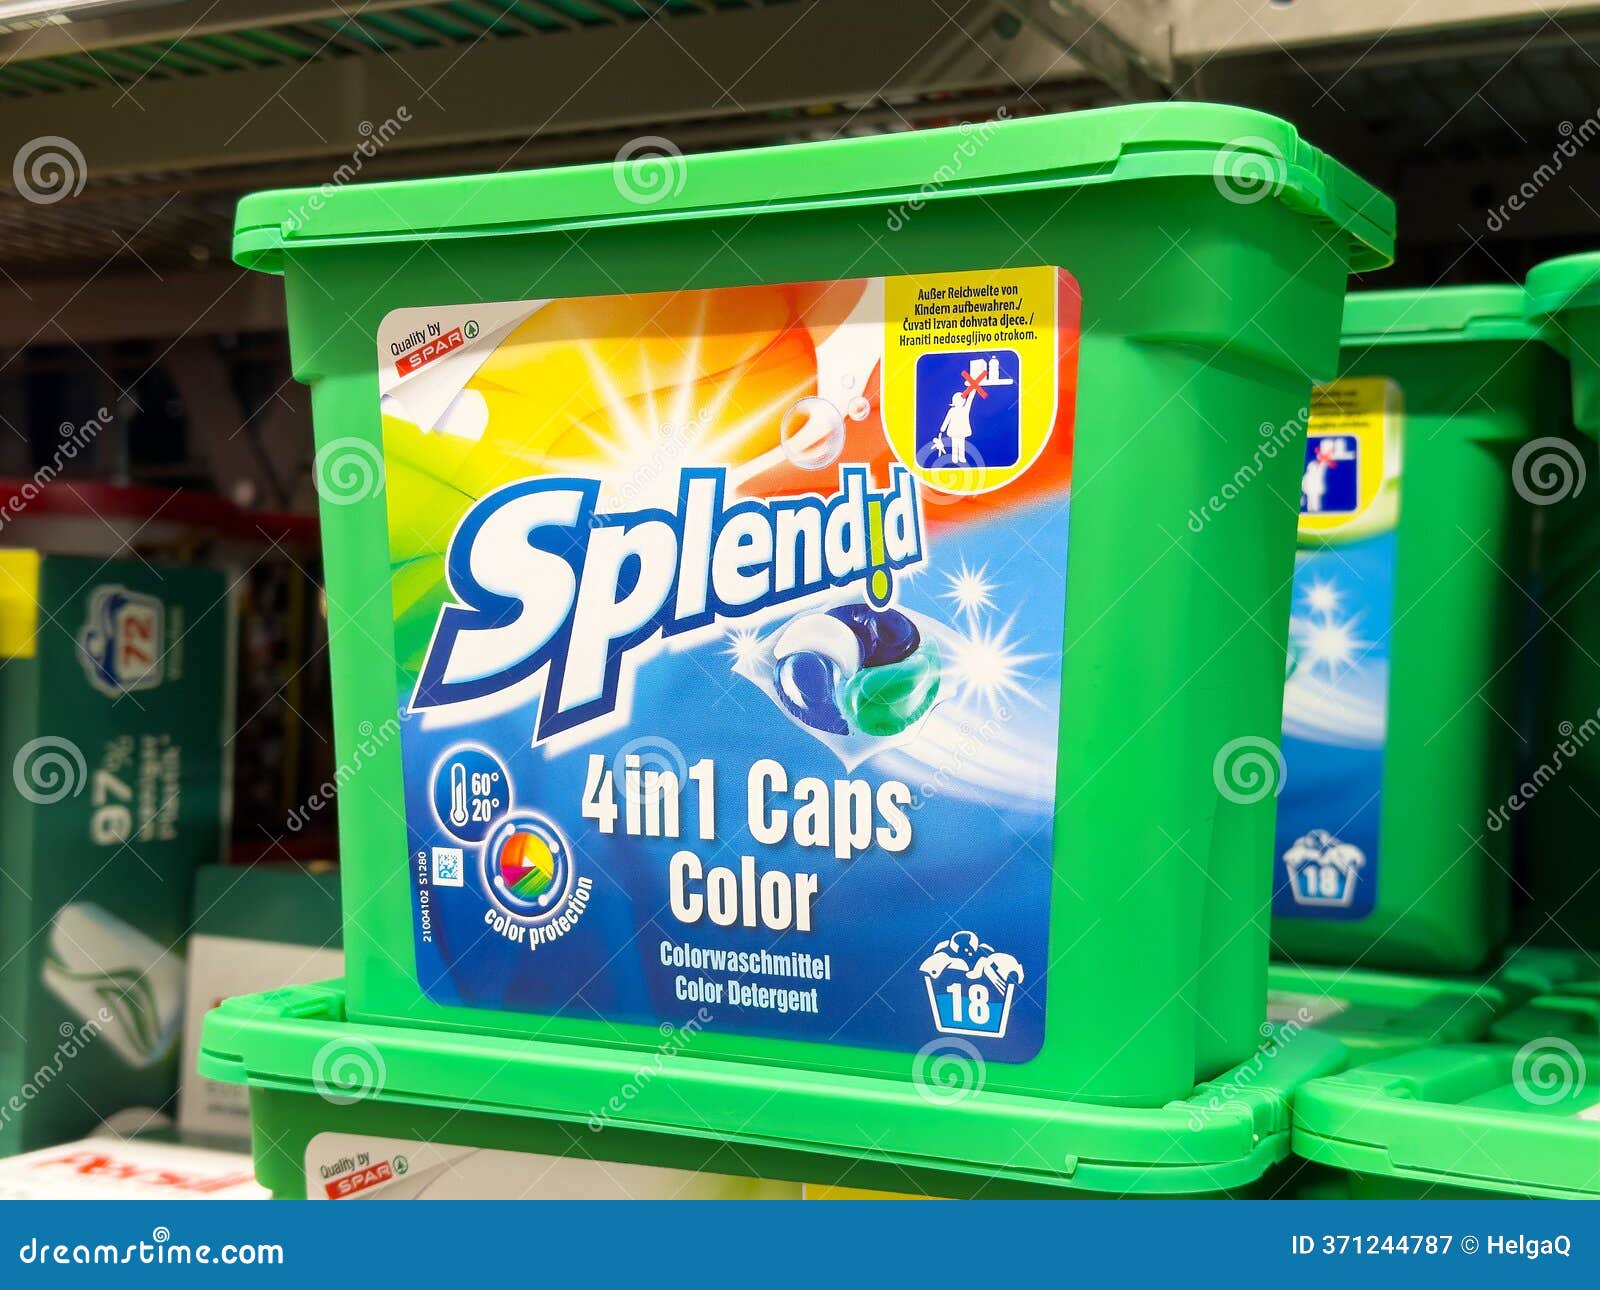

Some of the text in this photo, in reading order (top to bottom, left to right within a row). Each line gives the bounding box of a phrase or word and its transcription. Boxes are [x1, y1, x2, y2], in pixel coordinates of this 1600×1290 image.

[914, 303, 950, 316] Kindern
[918, 285, 1018, 301] Außer Reichweite von
[391, 322, 440, 356] Quality by
[899, 329, 1037, 346] Hraniti nedosegljivo otrokom.
[903, 317, 931, 331] Čuvati
[960, 316, 998, 328] dohvata
[409, 332, 462, 367] SPAR
[747, 758, 913, 859] Caps
[417, 851, 432, 943] 21004102 S1280
[669, 850, 818, 932] Color
[1303, 865, 1338, 897] 18
[484, 876, 593, 951] color protection
[660, 940, 831, 981] Colorwaschmittel
[675, 975, 819, 1013] Color Detergent
[946, 983, 990, 1025] 18
[320, 1152, 370, 1179] Quality by
[337, 1165, 392, 1194] SPAR
